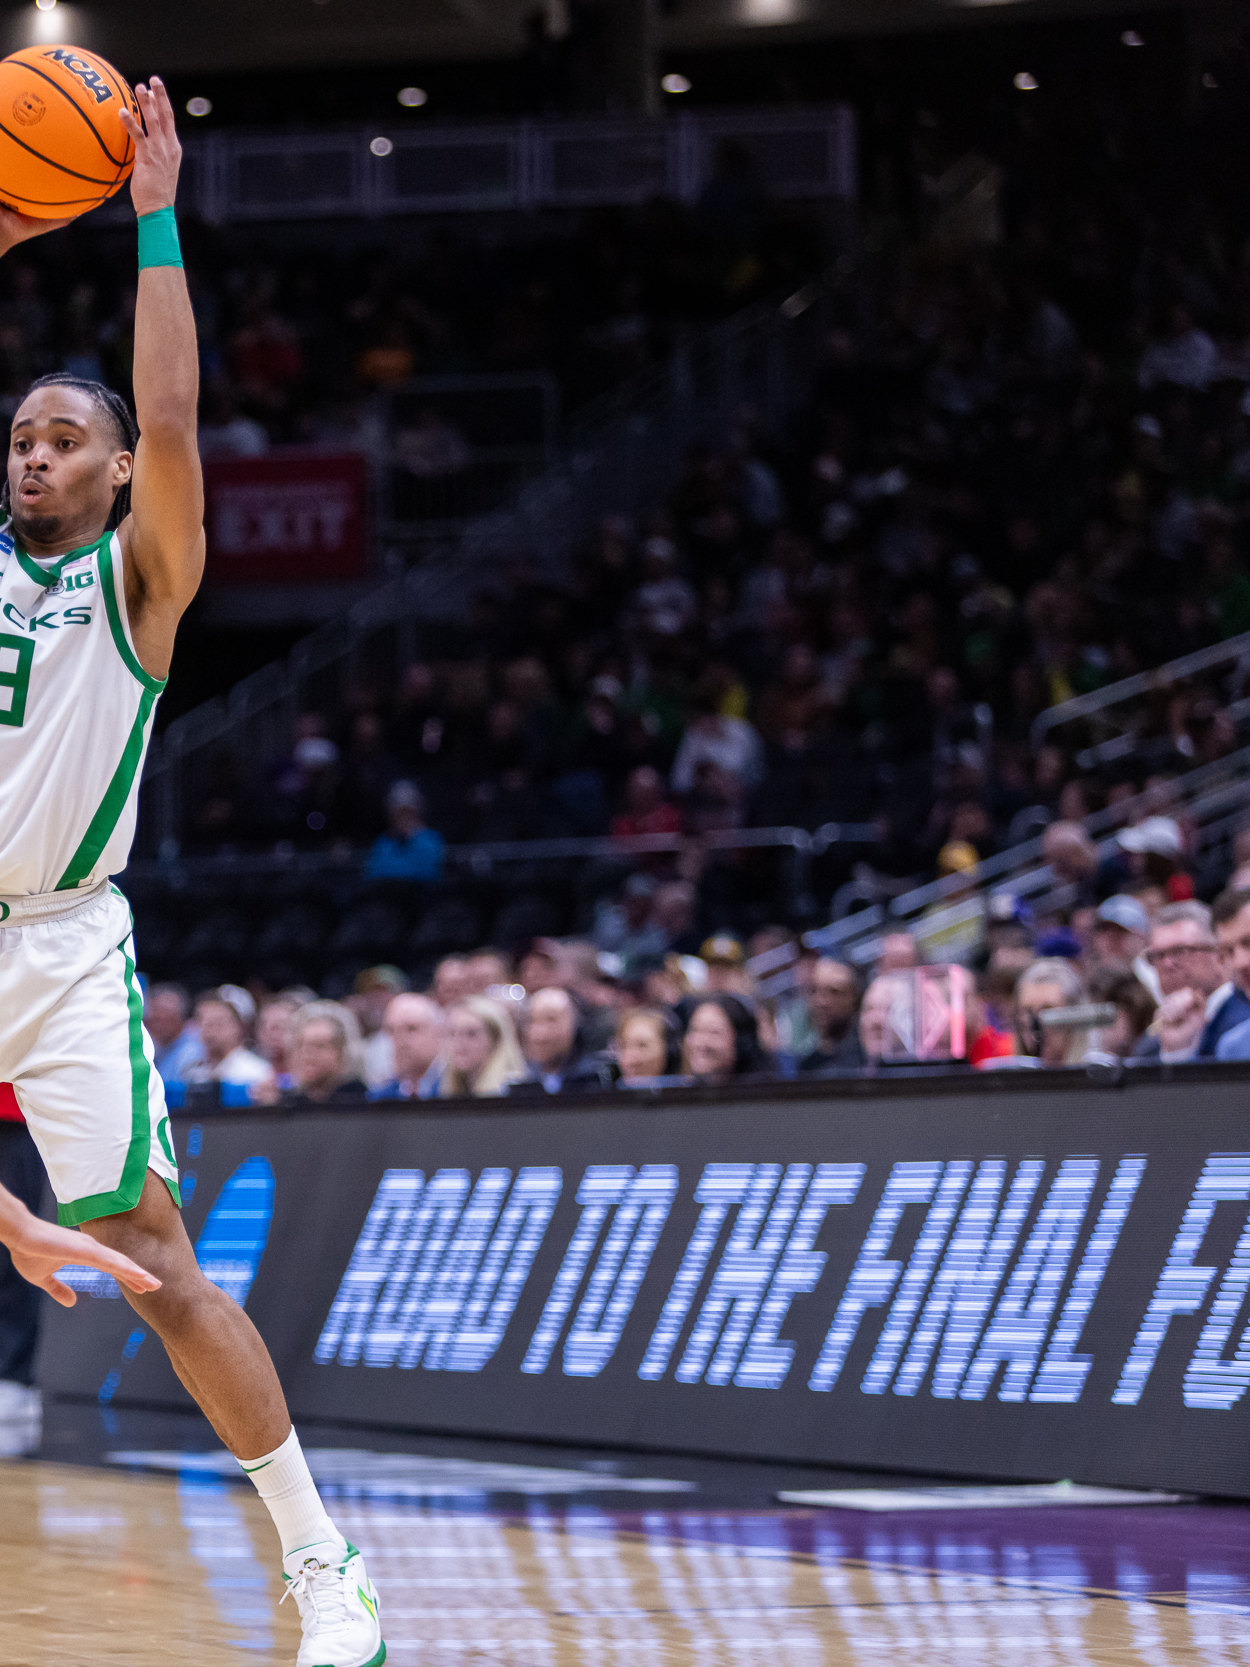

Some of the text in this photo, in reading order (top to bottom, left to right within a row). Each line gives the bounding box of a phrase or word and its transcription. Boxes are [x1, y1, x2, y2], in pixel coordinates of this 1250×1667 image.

[41, 48, 113, 104] NCAA
[312, 1168, 563, 1374] ROAD
[520, 1164, 679, 1377] TO
[636, 1162, 867, 1390] THE
[807, 1154, 1148, 1404] FINAL
